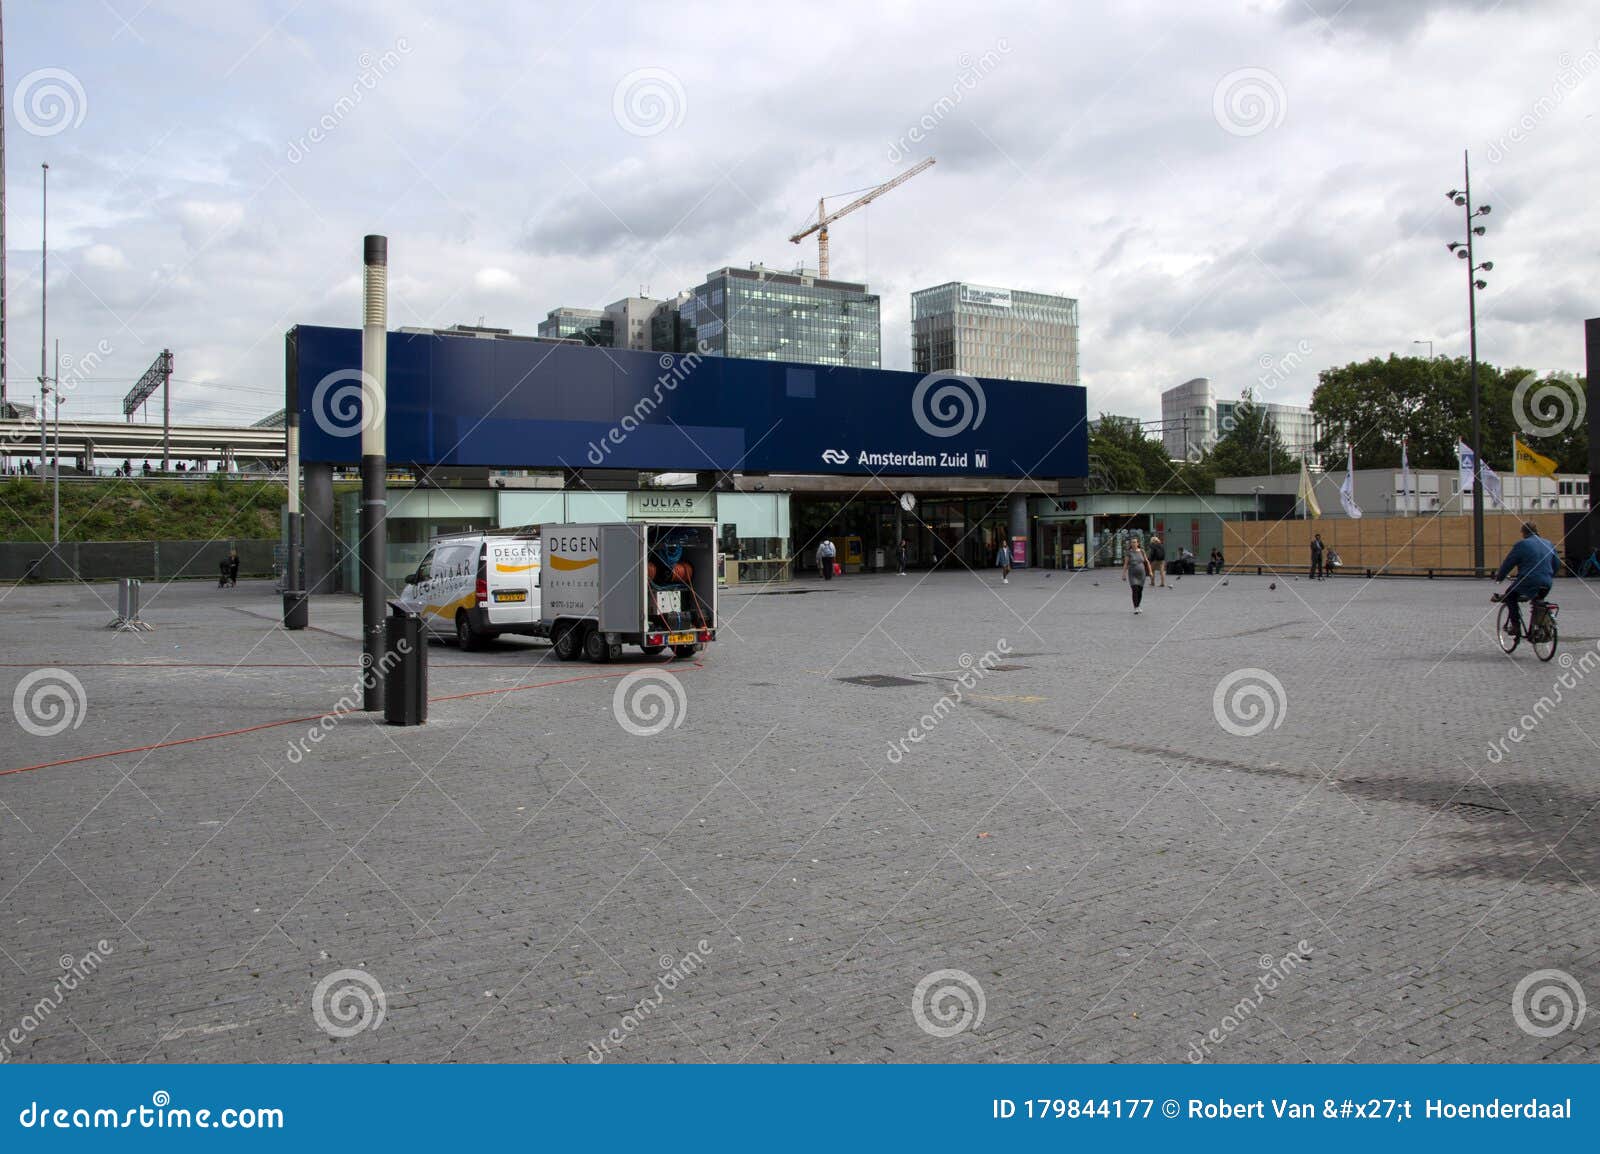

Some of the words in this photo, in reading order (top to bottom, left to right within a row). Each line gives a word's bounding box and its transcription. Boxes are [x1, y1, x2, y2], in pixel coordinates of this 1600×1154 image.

[858, 450, 936, 466] Amsterdam
[940, 452, 968, 467] Zuid
[975, 453, 987, 468] M
[642, 497, 693, 507] JULIA'S
[550, 536, 599, 552] DEGEN
